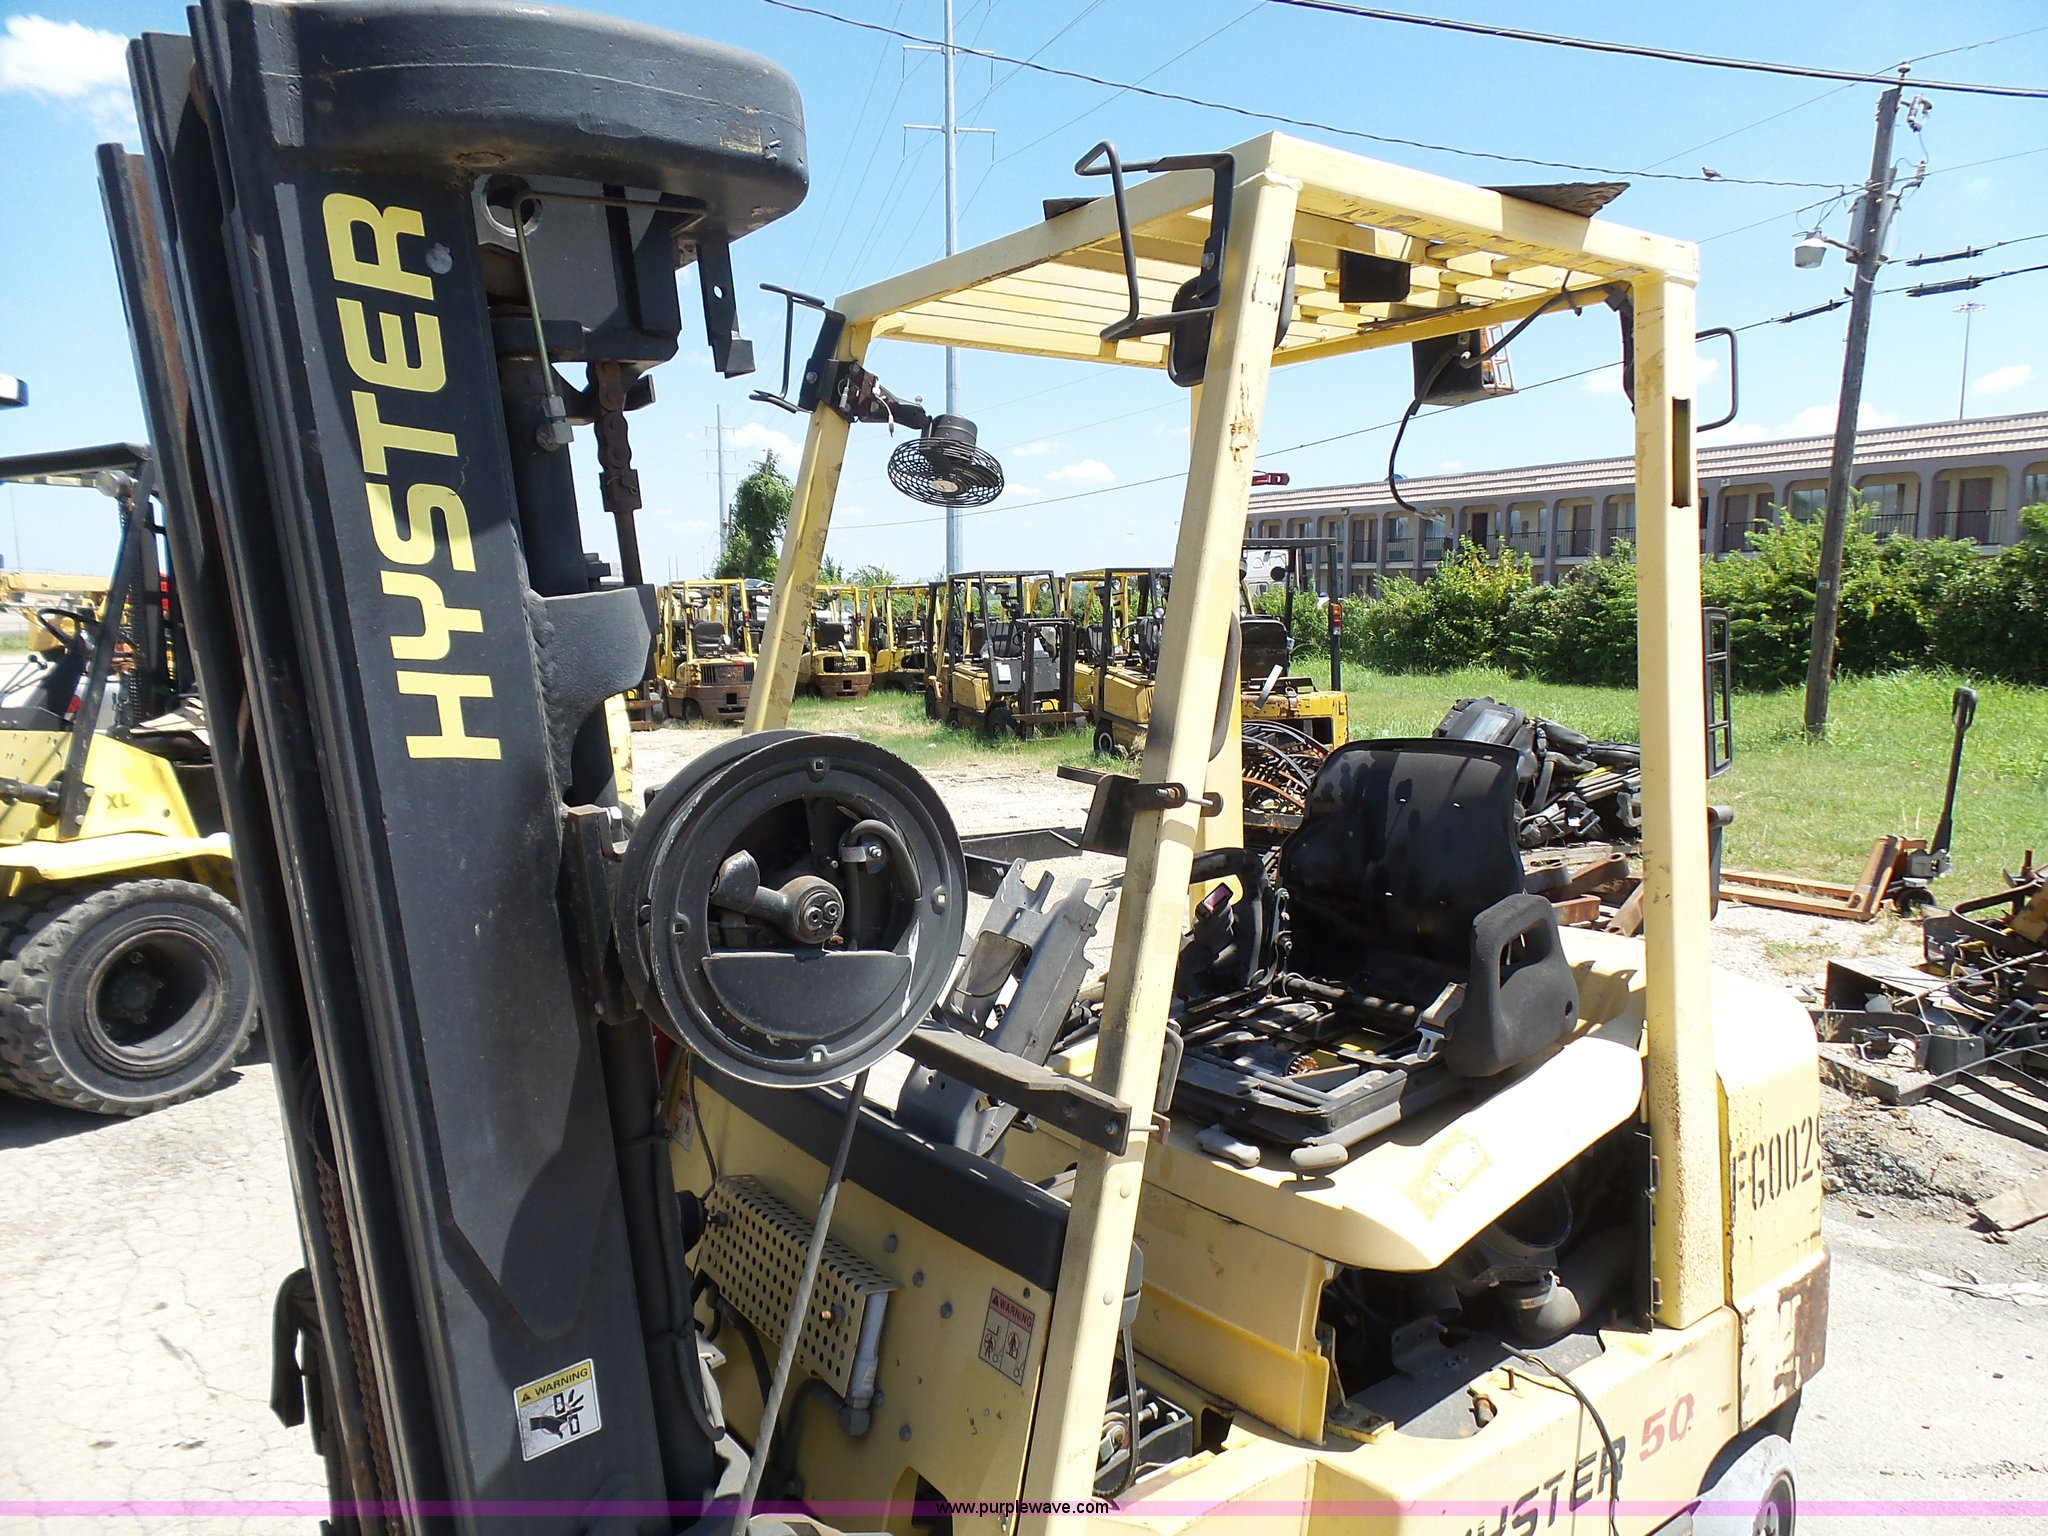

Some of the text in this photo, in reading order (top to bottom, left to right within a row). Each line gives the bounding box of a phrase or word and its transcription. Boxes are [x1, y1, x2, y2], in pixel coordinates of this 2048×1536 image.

[322, 192, 501, 760] HYSTER
[105, 794, 130, 809] XL
[1000, 1299, 1032, 1328] WARNING
[535, 1368, 588, 1396] WARNING
[1639, 1393, 1694, 1461] 50
[1465, 1436, 1625, 1536] YSTER
